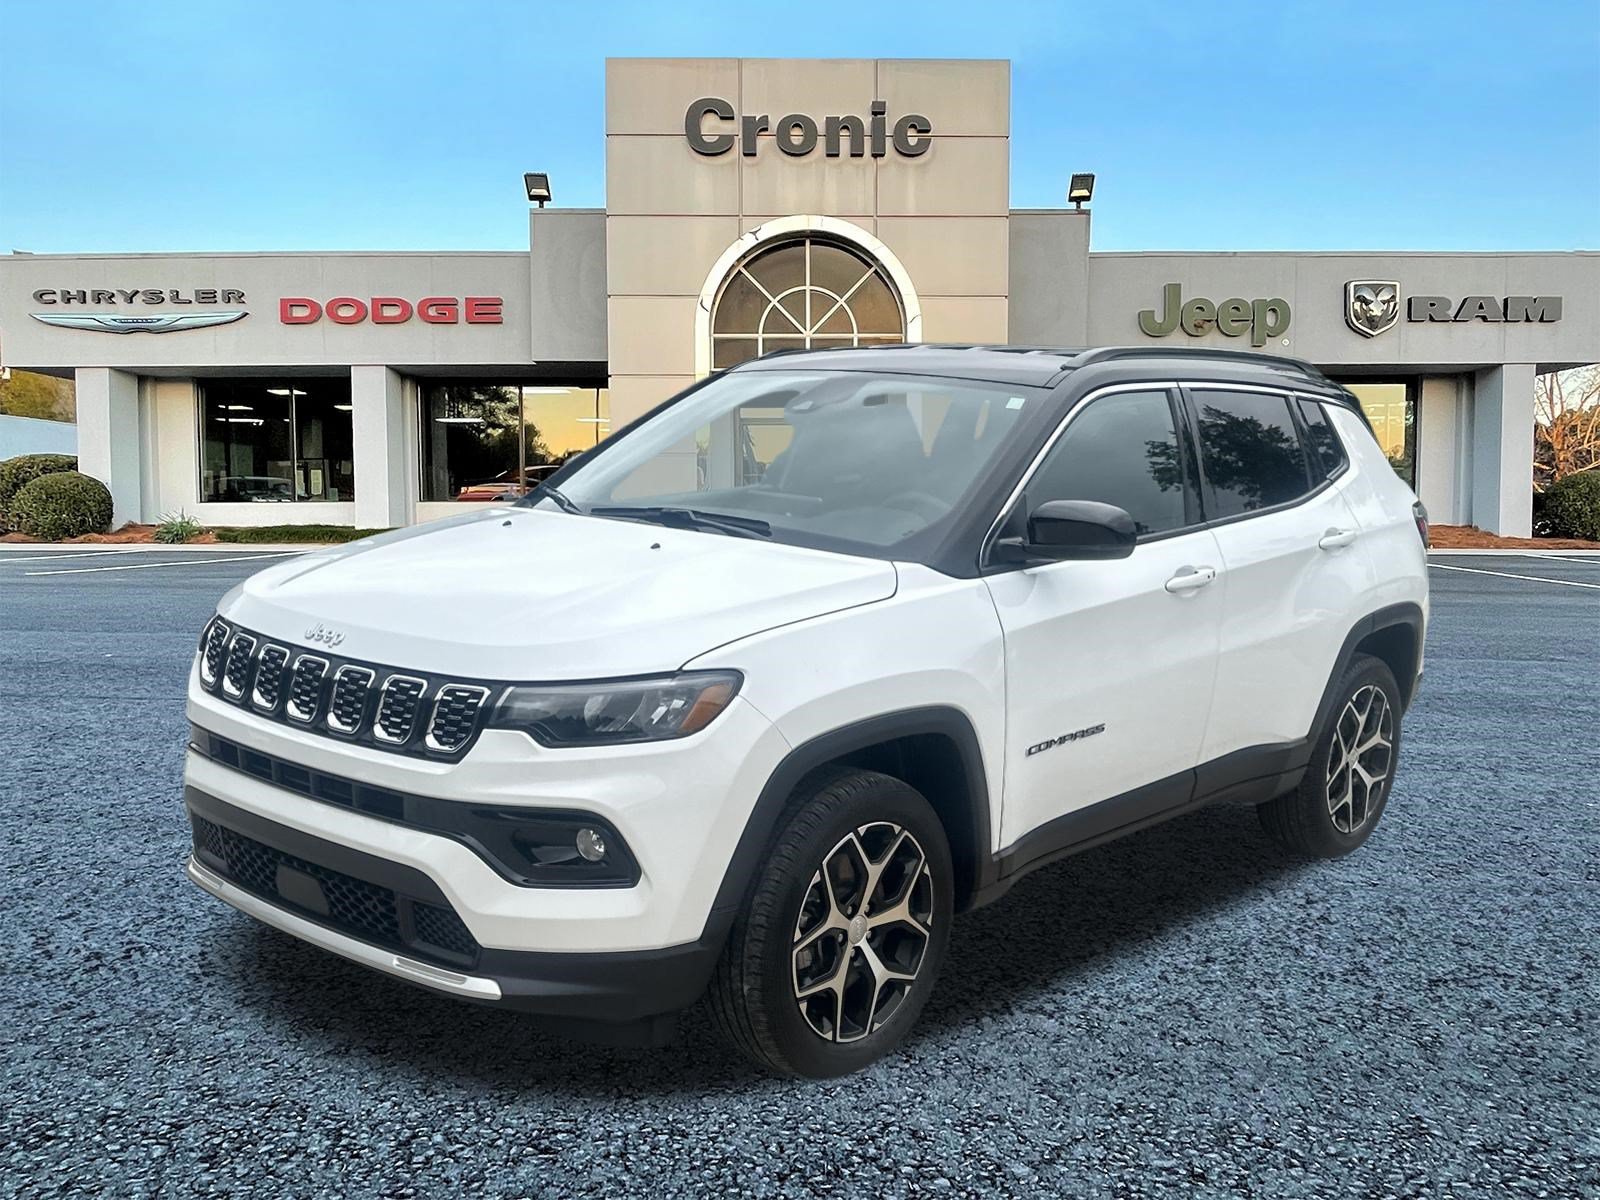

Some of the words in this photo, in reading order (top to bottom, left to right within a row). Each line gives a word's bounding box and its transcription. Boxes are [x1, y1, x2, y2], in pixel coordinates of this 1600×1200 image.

[684, 97, 932, 157] Cronic
[32, 288, 247, 305] CHRYSLER
[280, 296, 504, 325] DODGE
[1407, 296, 1563, 323] RAM
[1139, 283, 1291, 348] Jeep
[304, 622, 346, 649] Jeep
[1025, 722, 1106, 757] COMPASS
